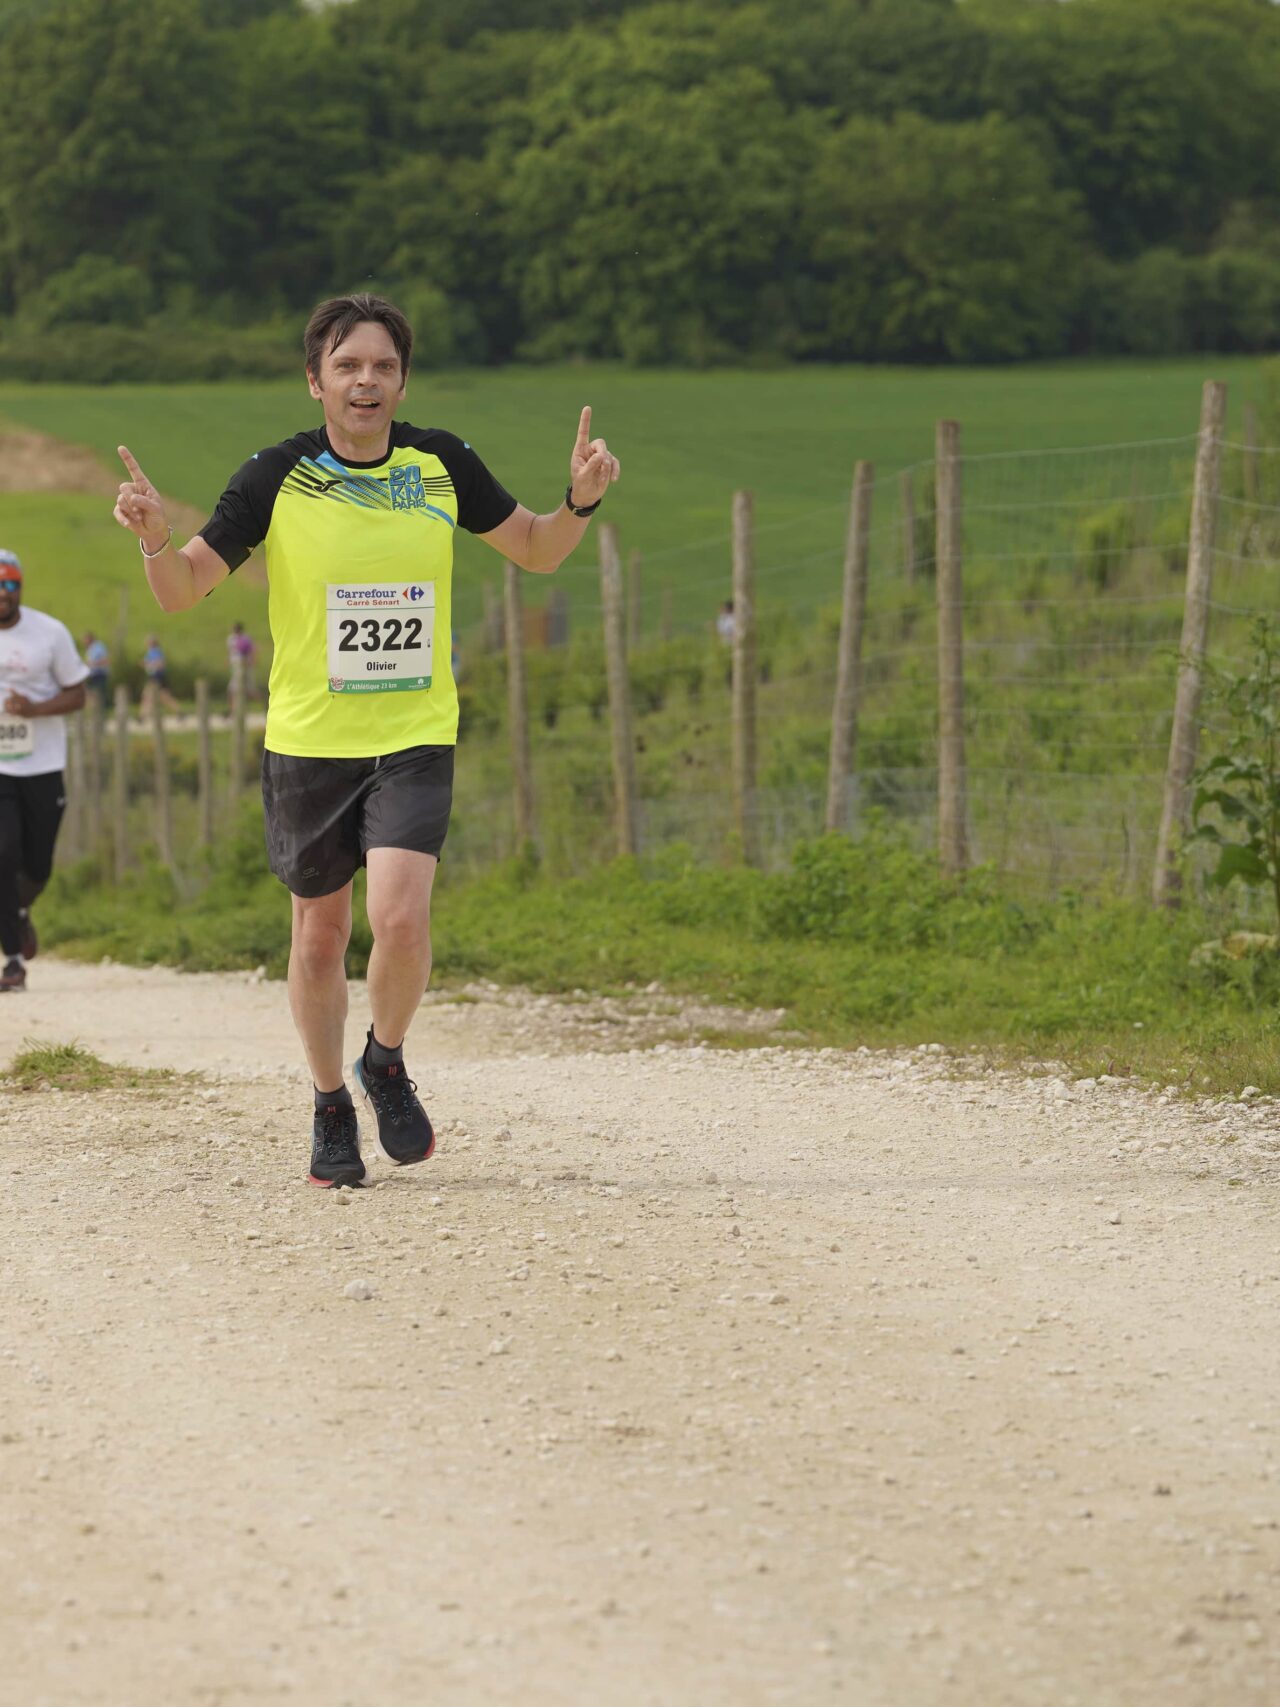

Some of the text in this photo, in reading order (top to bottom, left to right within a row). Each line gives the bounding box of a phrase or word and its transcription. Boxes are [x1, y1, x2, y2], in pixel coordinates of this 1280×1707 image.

[389, 466, 421, 486] 20
[390, 483, 425, 501] KM
[336, 589, 397, 599] Carrefour
[338, 618, 423, 651] 2322
[366, 661, 397, 671] Olivier
